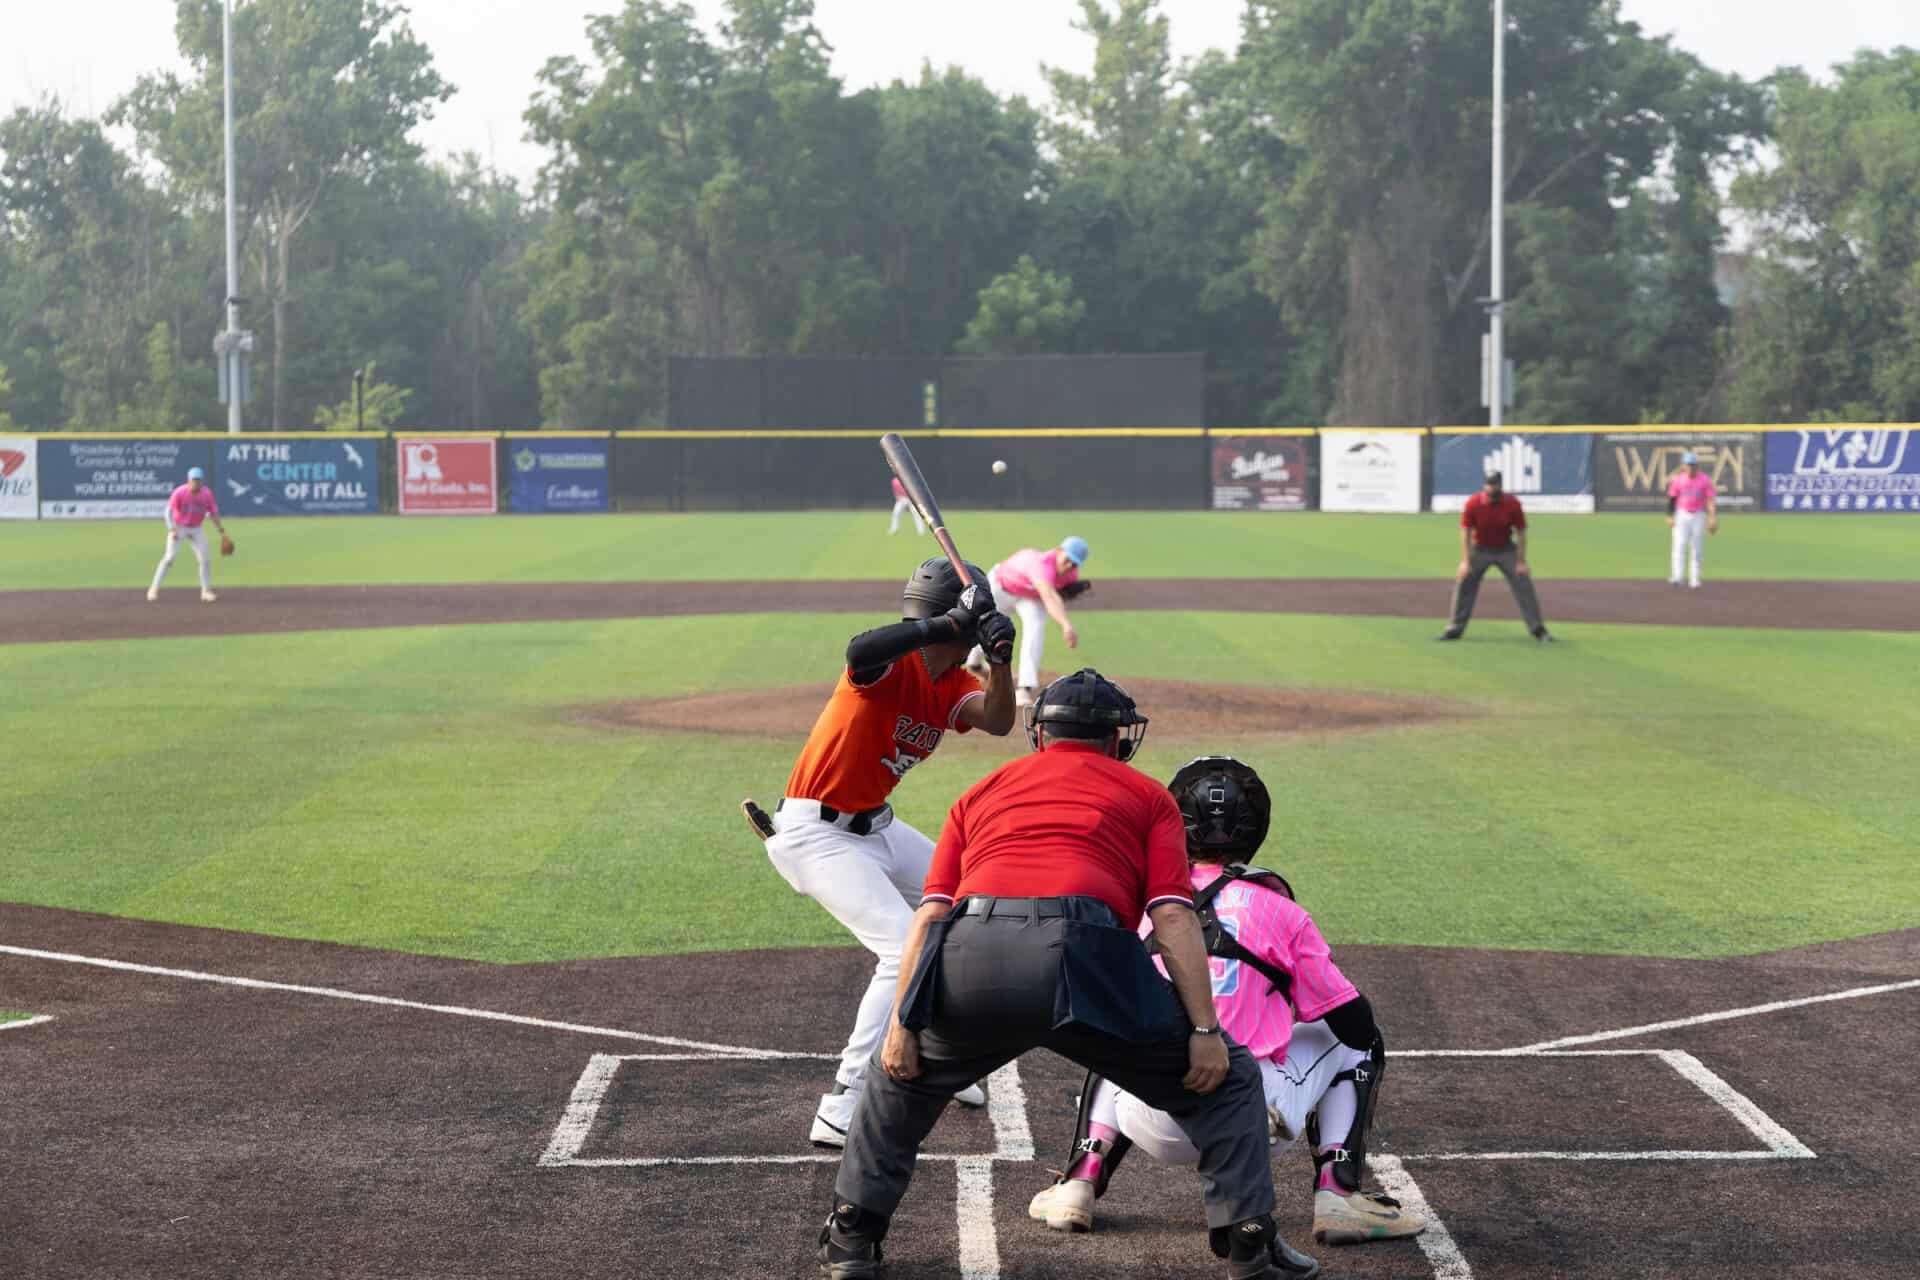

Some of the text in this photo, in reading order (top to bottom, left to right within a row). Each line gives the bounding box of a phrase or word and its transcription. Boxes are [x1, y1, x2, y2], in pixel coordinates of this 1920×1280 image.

[228, 445, 290, 461] AT THE
[406, 445, 443, 480] R
[257, 463, 337, 481] CENTER
[284, 482, 367, 499] OF IT ALL
